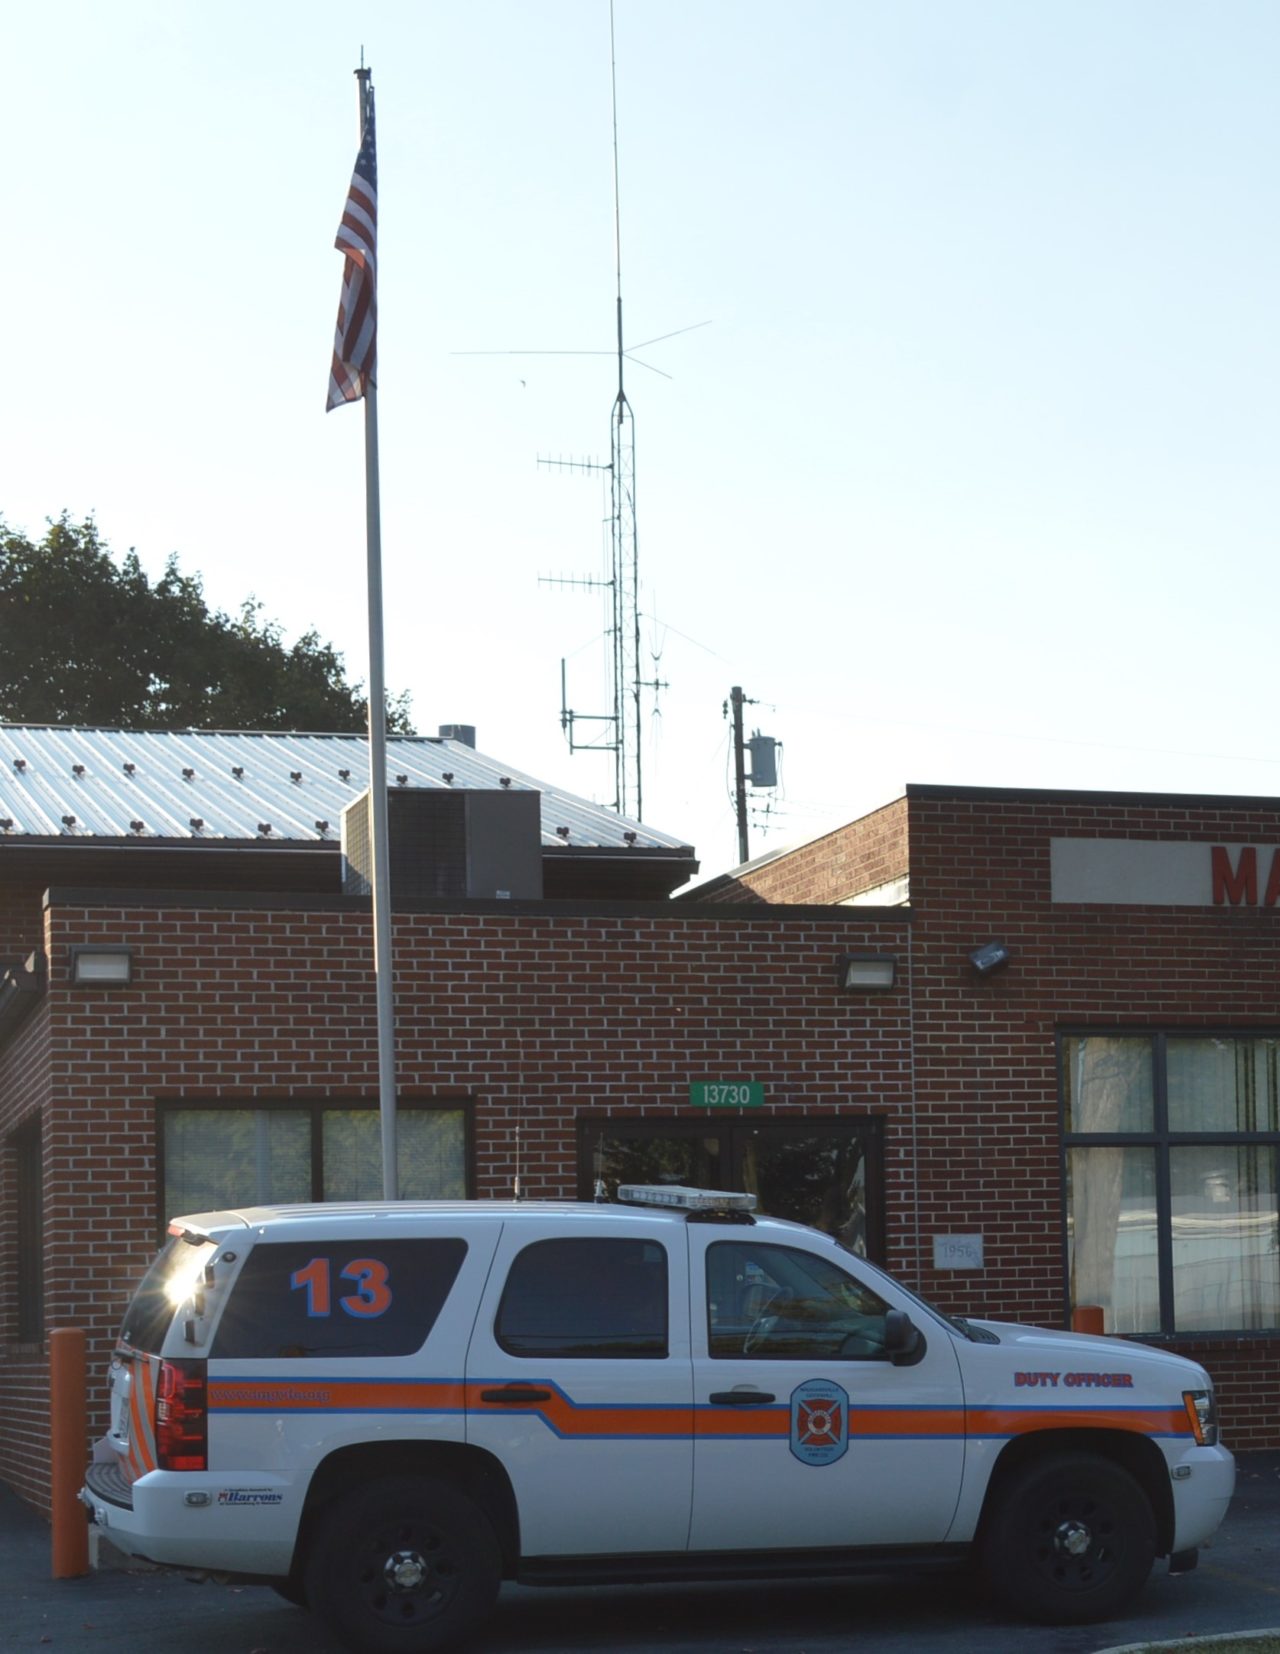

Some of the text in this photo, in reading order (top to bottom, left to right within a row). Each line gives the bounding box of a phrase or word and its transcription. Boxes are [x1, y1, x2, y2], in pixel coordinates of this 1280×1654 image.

[703, 1085, 750, 1104] 13730
[943, 1244, 973, 1258] 1956
[290, 1258, 393, 1319] 13
[1014, 1372, 1135, 1388] DUTY OFFICER
